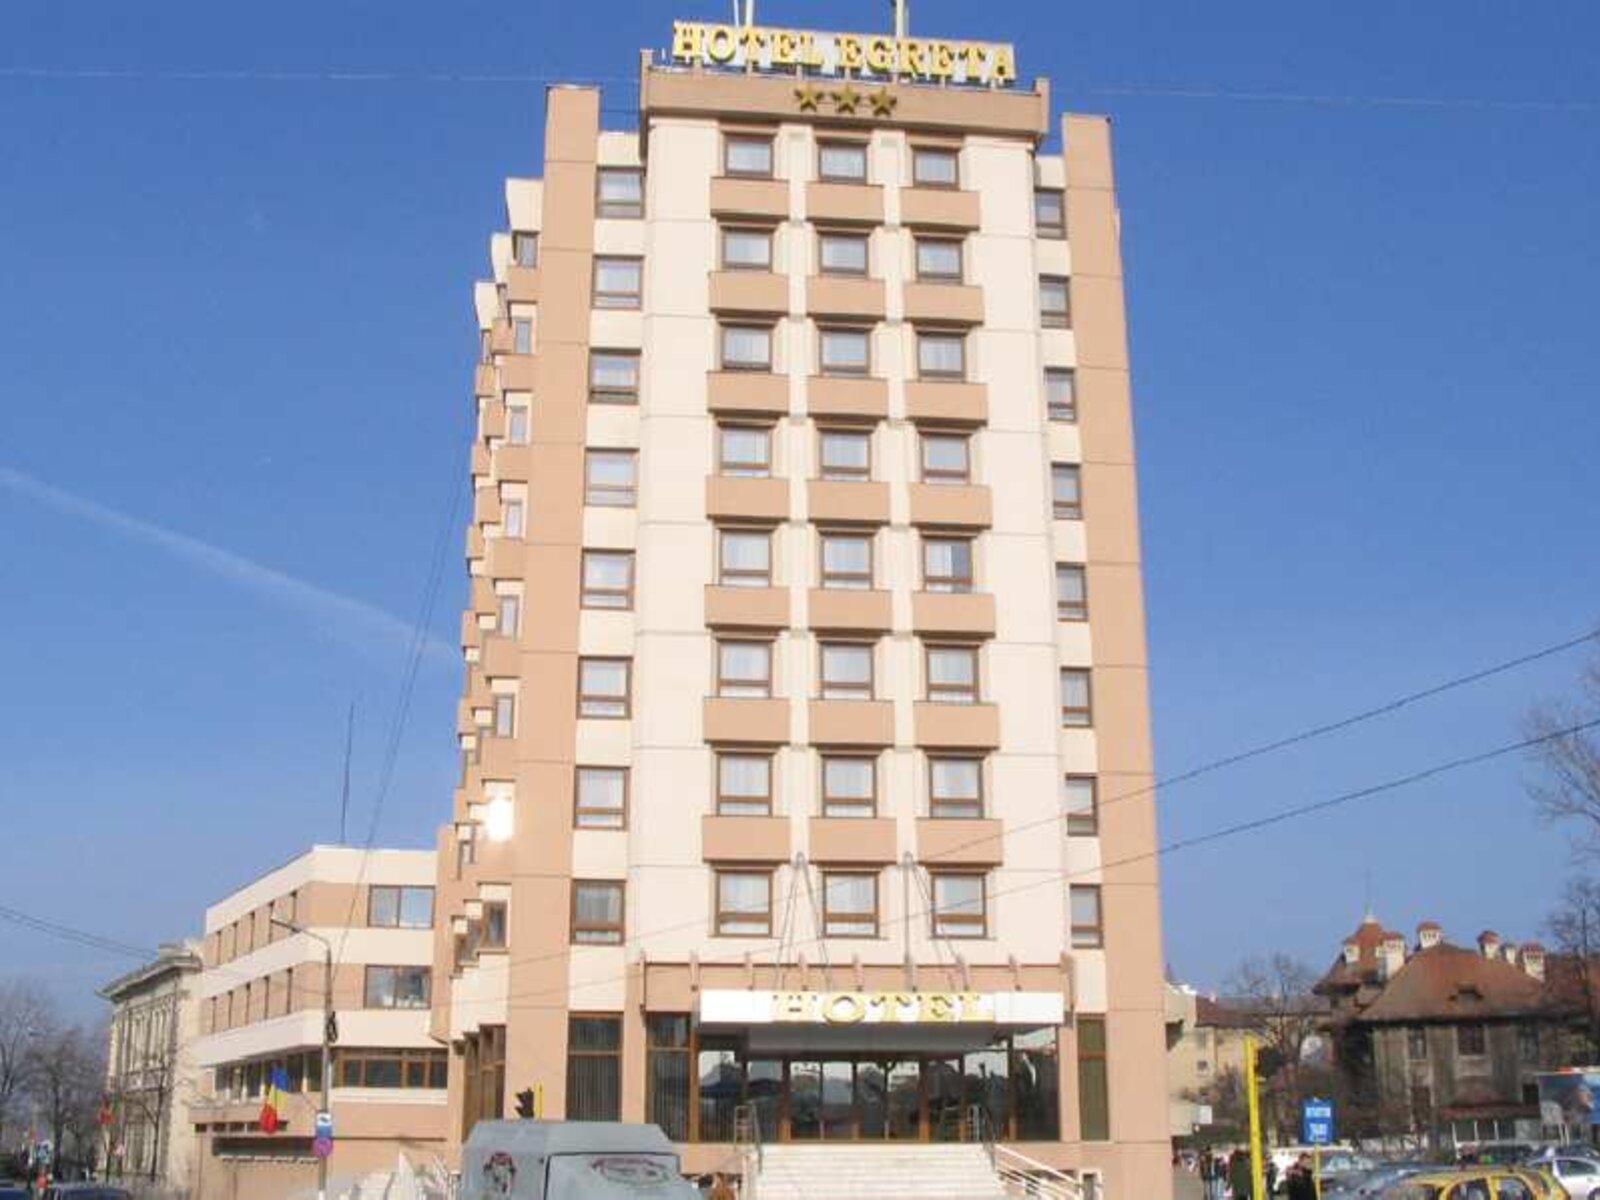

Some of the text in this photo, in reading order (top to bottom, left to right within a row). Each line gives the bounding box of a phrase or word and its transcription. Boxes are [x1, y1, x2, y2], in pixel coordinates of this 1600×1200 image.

[672, 22, 1016, 81] HOTEL EGRETA
[772, 992, 994, 1024] HOTEL
